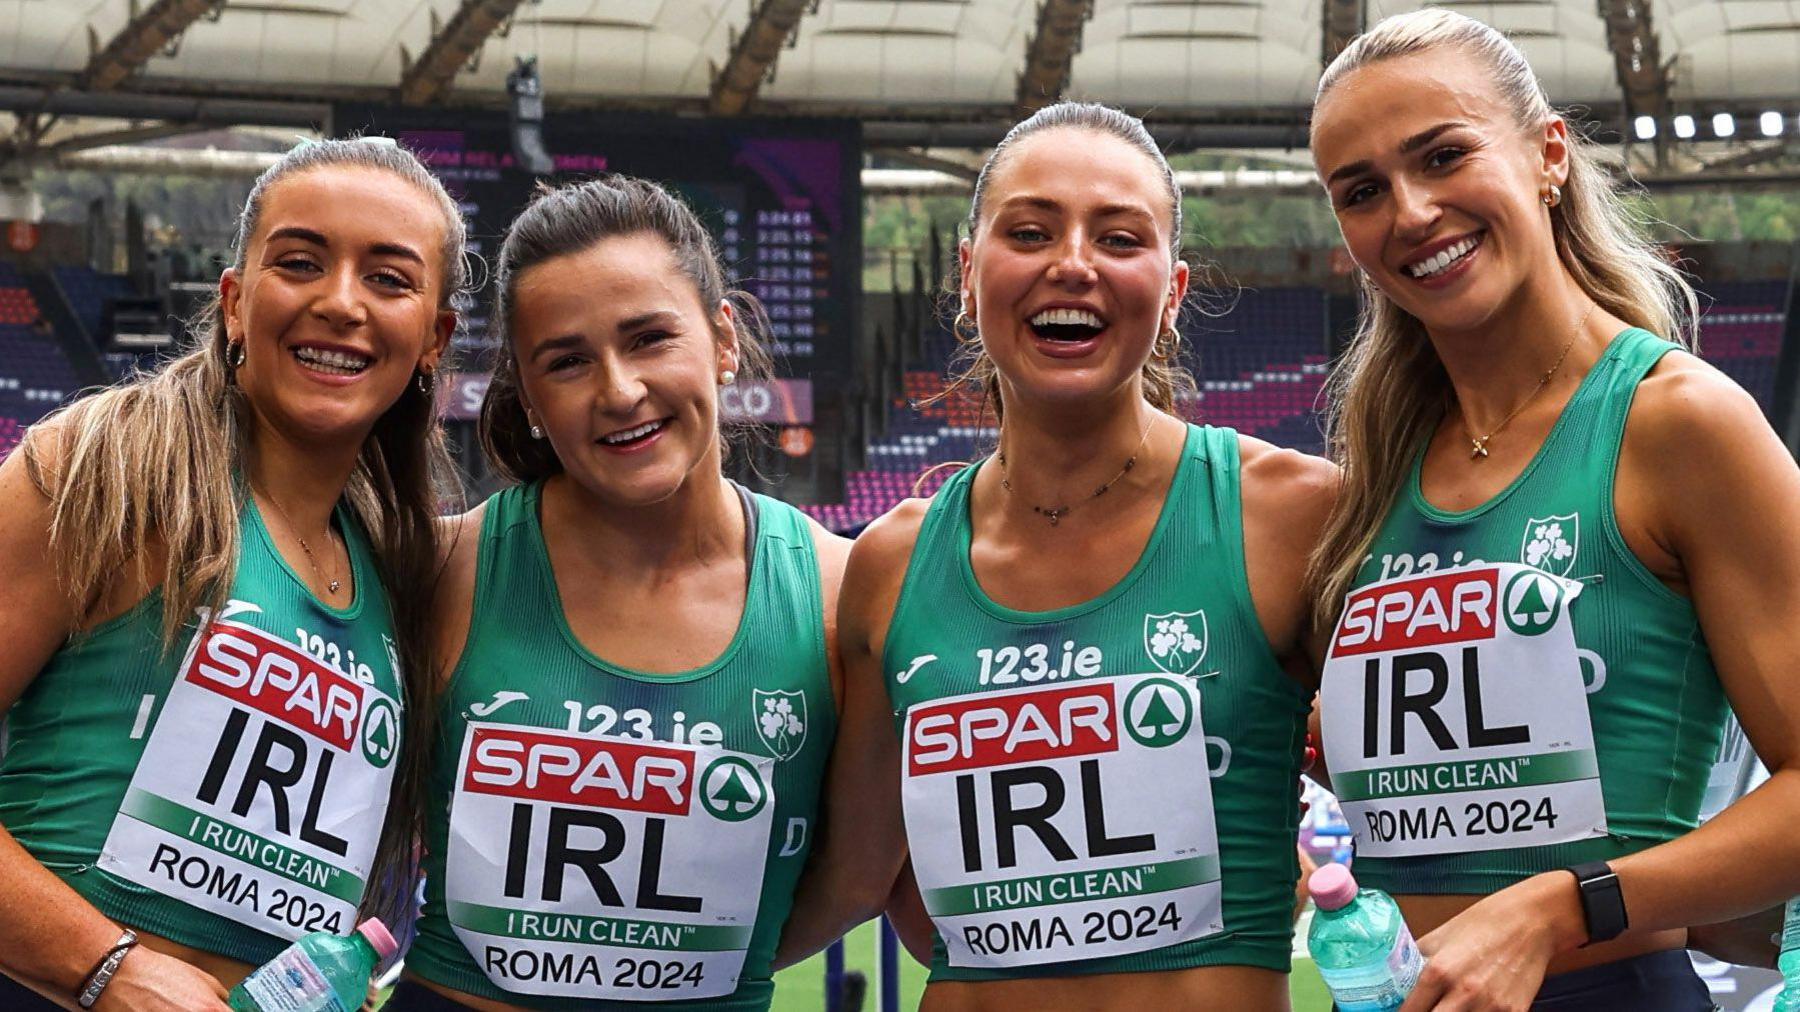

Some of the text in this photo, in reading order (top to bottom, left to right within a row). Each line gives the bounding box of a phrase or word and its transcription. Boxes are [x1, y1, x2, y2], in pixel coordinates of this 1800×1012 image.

[1338, 580, 1493, 647] SPAR
[296, 628, 375, 685] 123ie
[976, 640, 1102, 686] 123.ie
[199, 633, 359, 740] SPAR
[1363, 646, 1531, 759] IRL
[563, 700, 723, 749] 123ie
[914, 695, 1112, 765] SPAR
[196, 707, 349, 858] IRL
[472, 739, 688, 805] SPAR
[1368, 774, 1375, 795] I
[1377, 769, 1429, 793] RUN
[188, 816, 200, 836] I
[202, 823, 260, 861] RUN
[956, 759, 1156, 873] IRL
[1364, 797, 1558, 843] ROMA 2024
[504, 803, 703, 913] IRL
[149, 843, 341, 935] ROMA 2024
[973, 888, 981, 909] I
[985, 880, 1043, 907] RUN
[507, 912, 515, 934] I
[520, 915, 582, 939] RUN
[963, 901, 1182, 956] ROMA 2024
[485, 946, 704, 990] ROMA 2024
